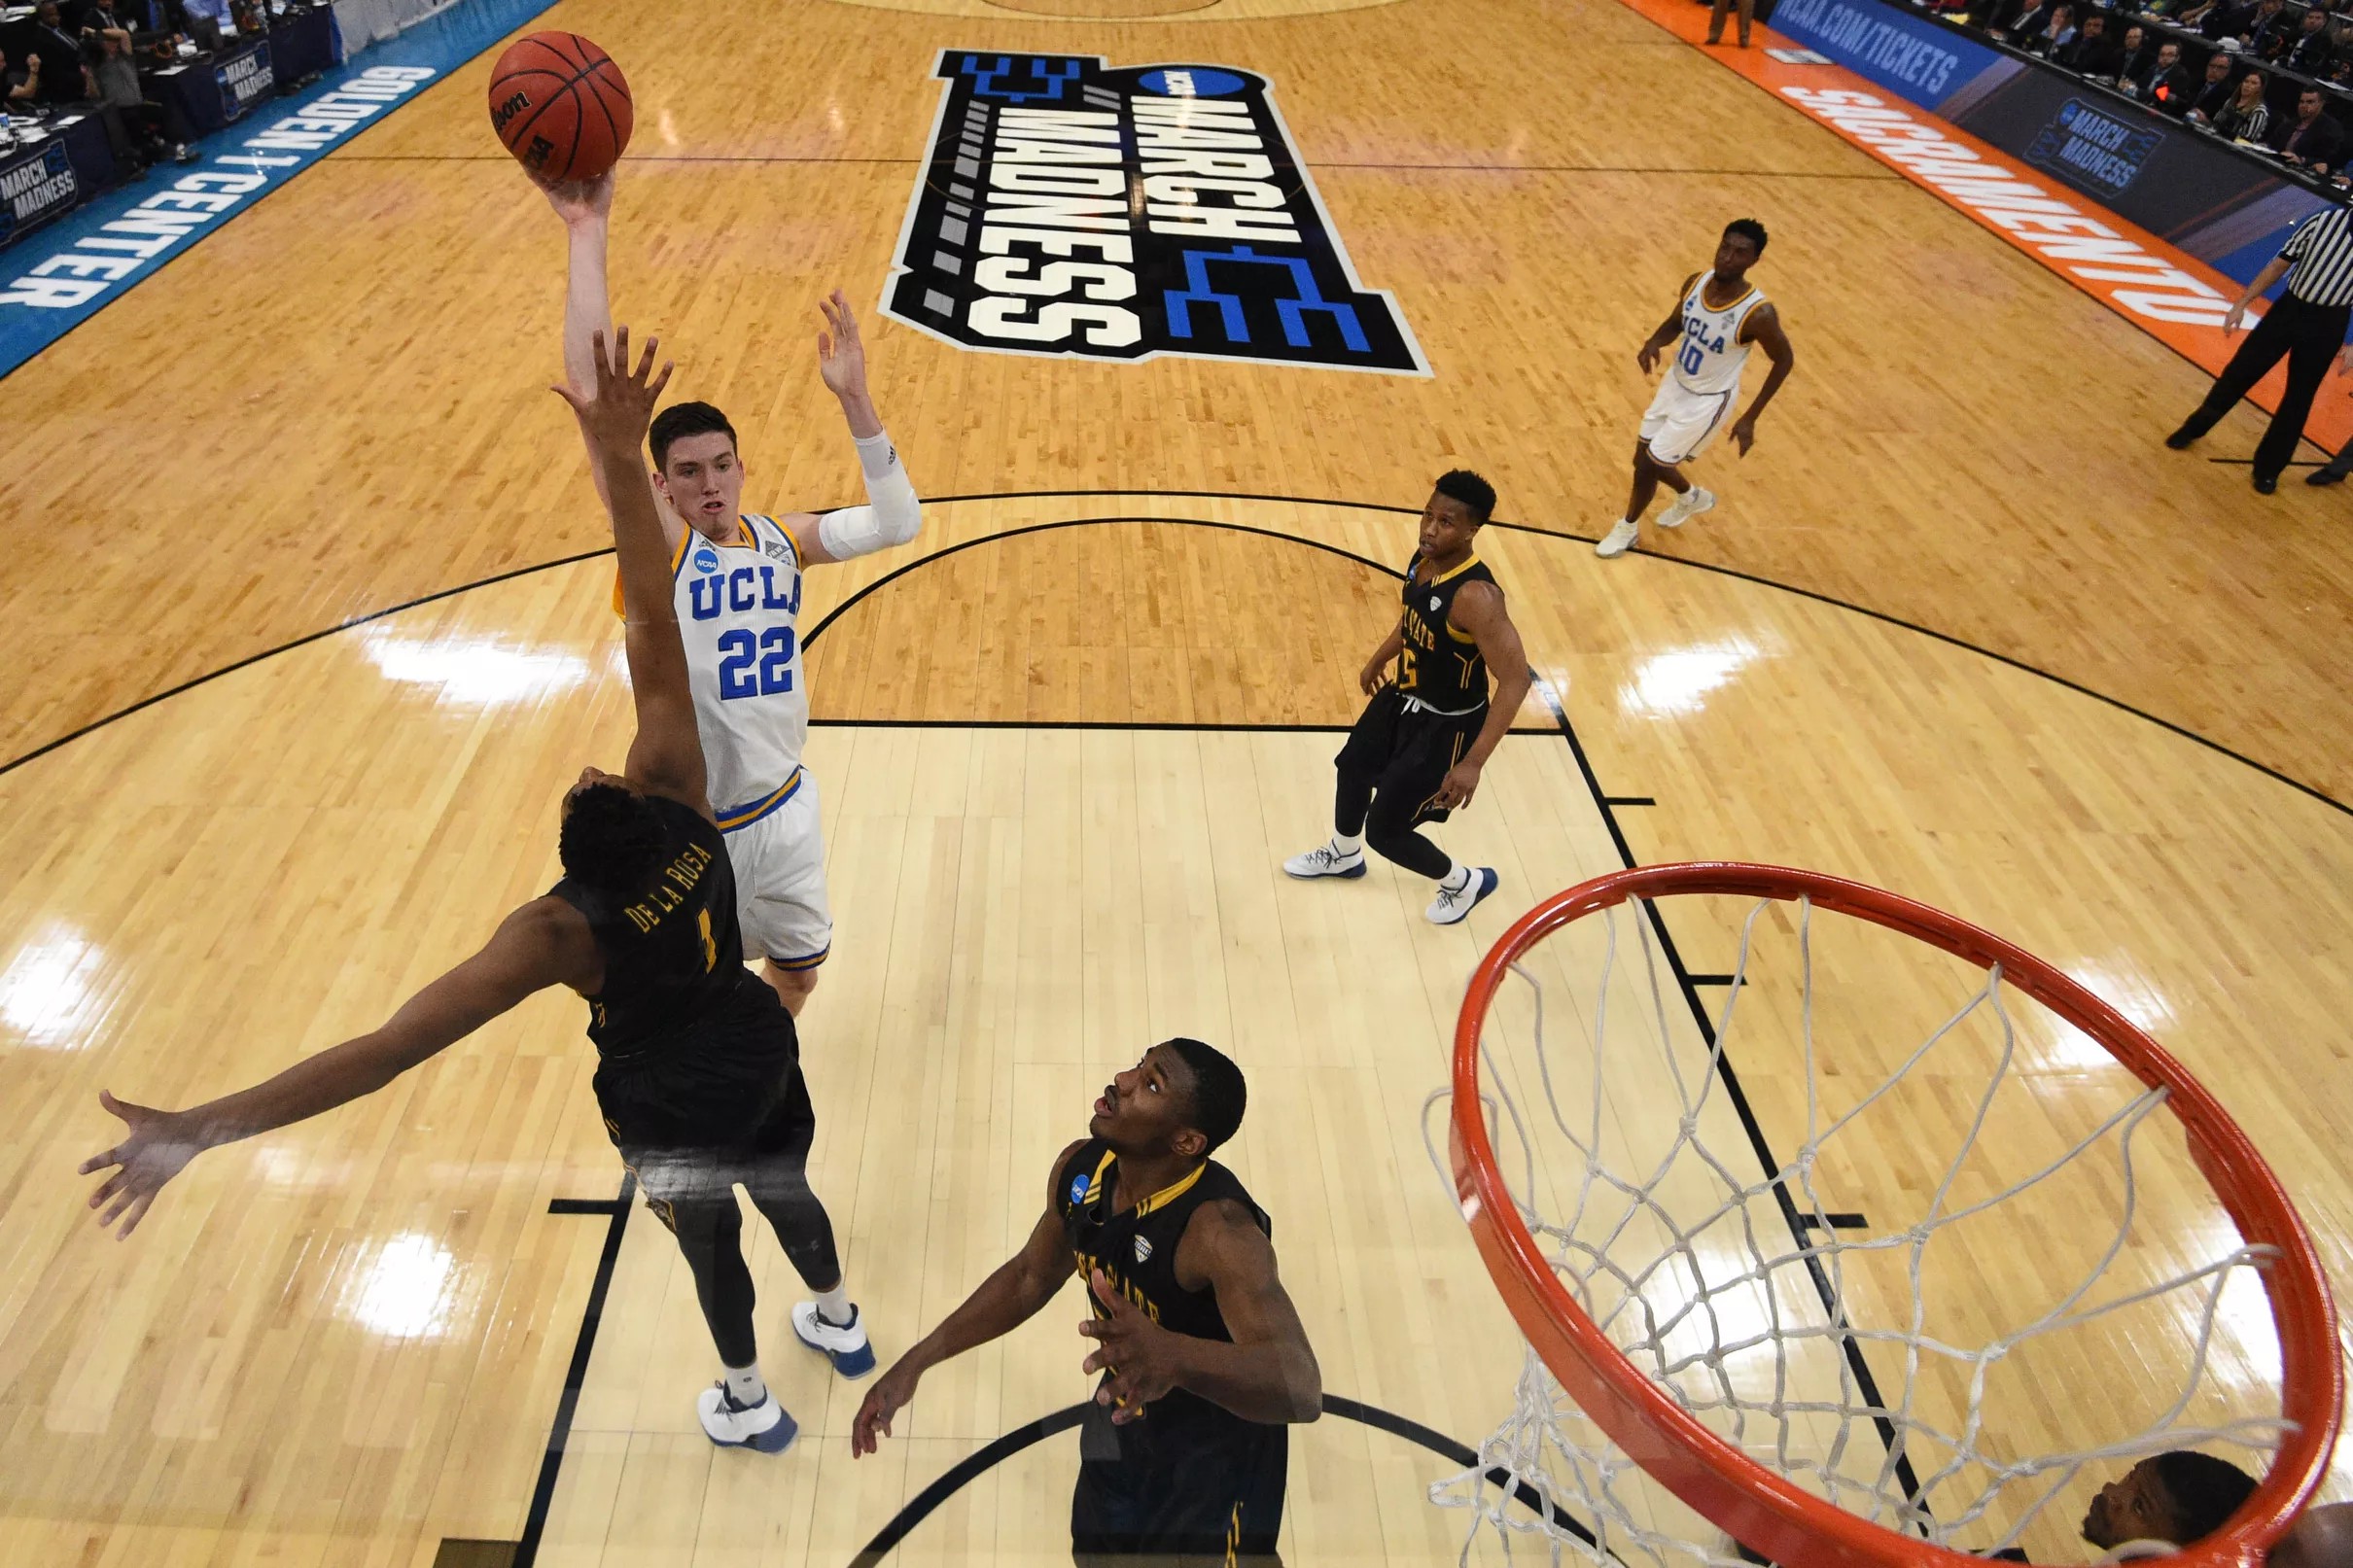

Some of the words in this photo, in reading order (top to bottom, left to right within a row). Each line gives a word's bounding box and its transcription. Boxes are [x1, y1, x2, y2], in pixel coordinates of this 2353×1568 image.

[243, 66, 437, 150] GOLDEN
[2068, 109, 2130, 152] MARCH
[0, 157, 48, 200] MARCH
[1131, 95, 1302, 243] MARCH
[2058, 135, 2139, 189] MADNESS
[14, 170, 75, 220] MADNESS
[1779, 87, 2262, 331] SACRAMENTO
[0, 172, 268, 308] CENTER
[967, 107, 1142, 347] MADNESS
[1679, 337, 1704, 376] 10
[696, 559, 717, 570] NCAA
[689, 566, 801, 621] UCLA
[719, 626, 795, 701] 22
[665, 842, 713, 890] ROSA
[623, 903, 661, 933] DE
[648, 886, 684, 913] LA
